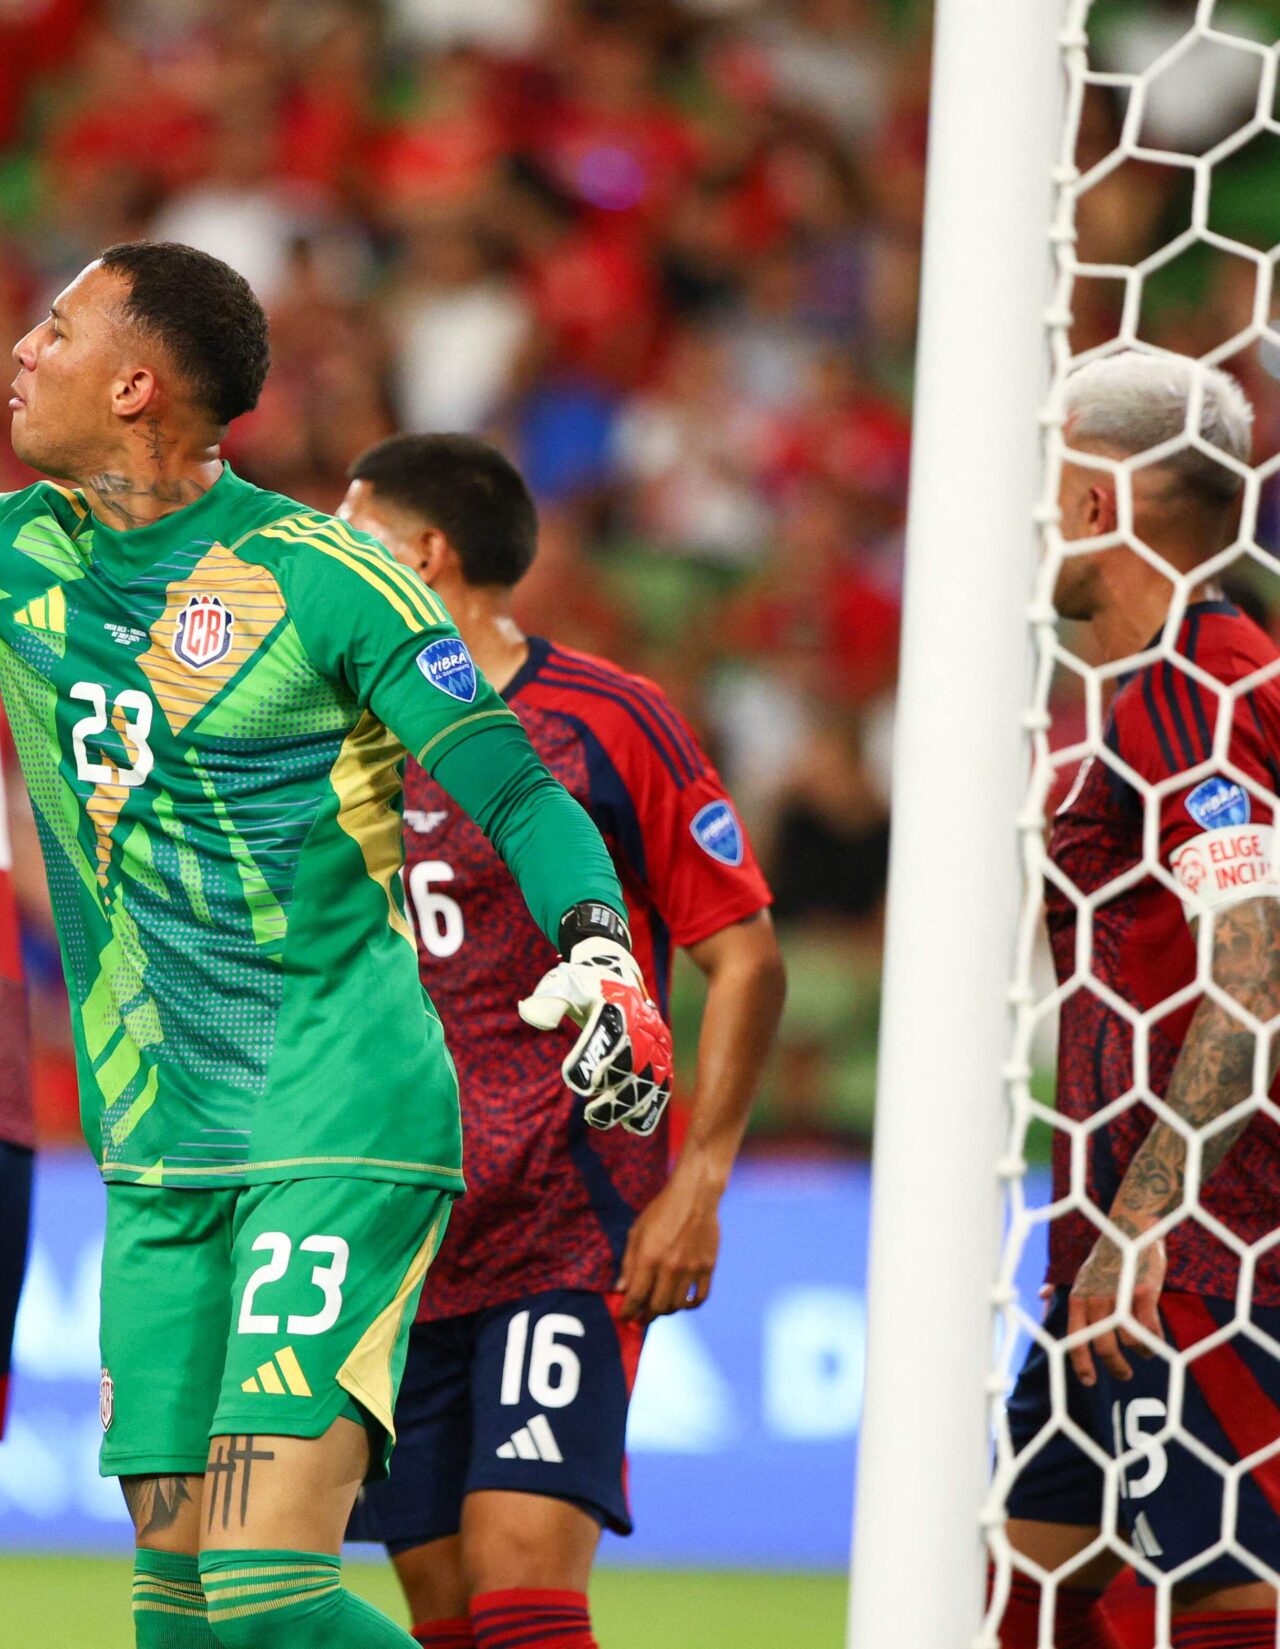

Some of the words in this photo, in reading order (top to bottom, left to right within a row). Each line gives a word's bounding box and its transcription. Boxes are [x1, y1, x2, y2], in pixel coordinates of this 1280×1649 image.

[186, 608, 221, 657] CR
[429, 652, 468, 675] VIBRA
[70, 681, 154, 786] 23
[1208, 834, 1263, 863] ELIGE
[398, 860, 465, 958] 6
[236, 1231, 350, 1336] 23
[500, 1310, 586, 1409] 16
